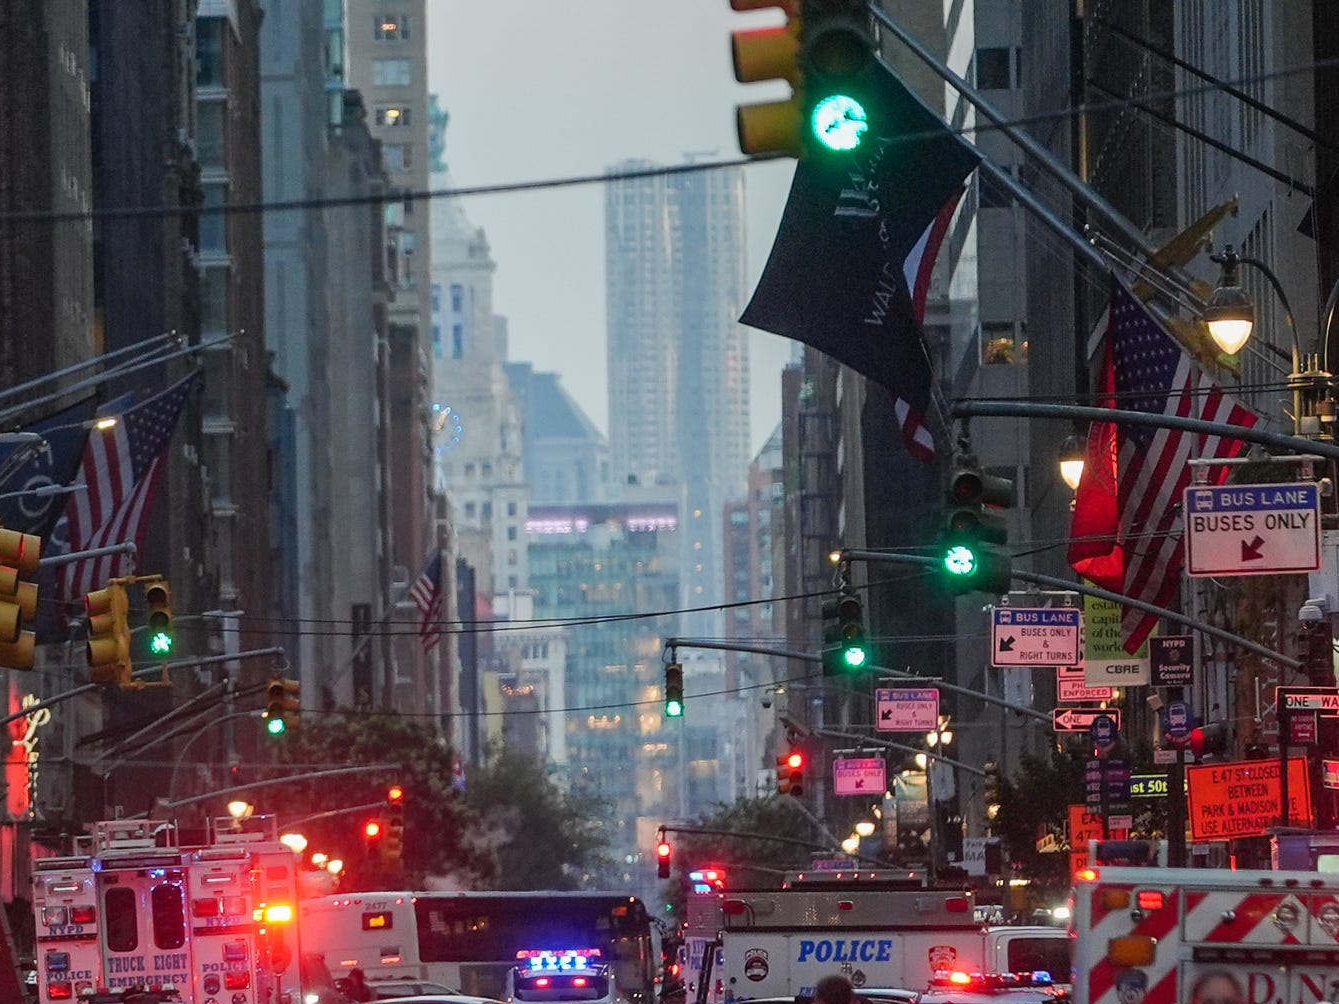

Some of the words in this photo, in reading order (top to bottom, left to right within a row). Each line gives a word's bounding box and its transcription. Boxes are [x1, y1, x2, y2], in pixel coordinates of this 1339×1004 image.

[1220, 491, 1255, 507] BUS
[1261, 490, 1309, 505] LANE
[1194, 514, 1255, 532] BUSES
[1265, 512, 1310, 530] ONLY
[1016, 613, 1038, 622] BUS
[1042, 613, 1073, 622] LANE
[1020, 628, 1048, 637] BUSES
[1050, 627, 1072, 637] ONLY
[1042, 640, 1049, 648] &
[1020, 651, 1043, 660] RIGHT
[1046, 651, 1073, 660] TURNS
[1106, 664, 1140, 675] CBRE
[1158, 663, 1191, 673] Security
[1160, 672, 1191, 680] Camera
[1063, 689, 1108, 697] ENFORCED
[1286, 696, 1309, 707] ONE
[1321, 696, 1339, 707] WA
[1062, 715, 1082, 724] ONE
[1227, 783, 1268, 799] BETWEEN
[1201, 802, 1225, 818] PARK
[1228, 802, 1234, 815] &
[1237, 799, 1278, 814] MADISON
[1201, 820, 1219, 835] USE
[206, 917, 240, 927] NYPD
[49, 926, 84, 936] NYPD
[797, 939, 893, 963] POLICE
[108, 956, 145, 973] TRUCK
[154, 953, 188, 971] EIGHT
[46, 970, 92, 981] POLICE
[109, 973, 189, 987] EMERGENCY
